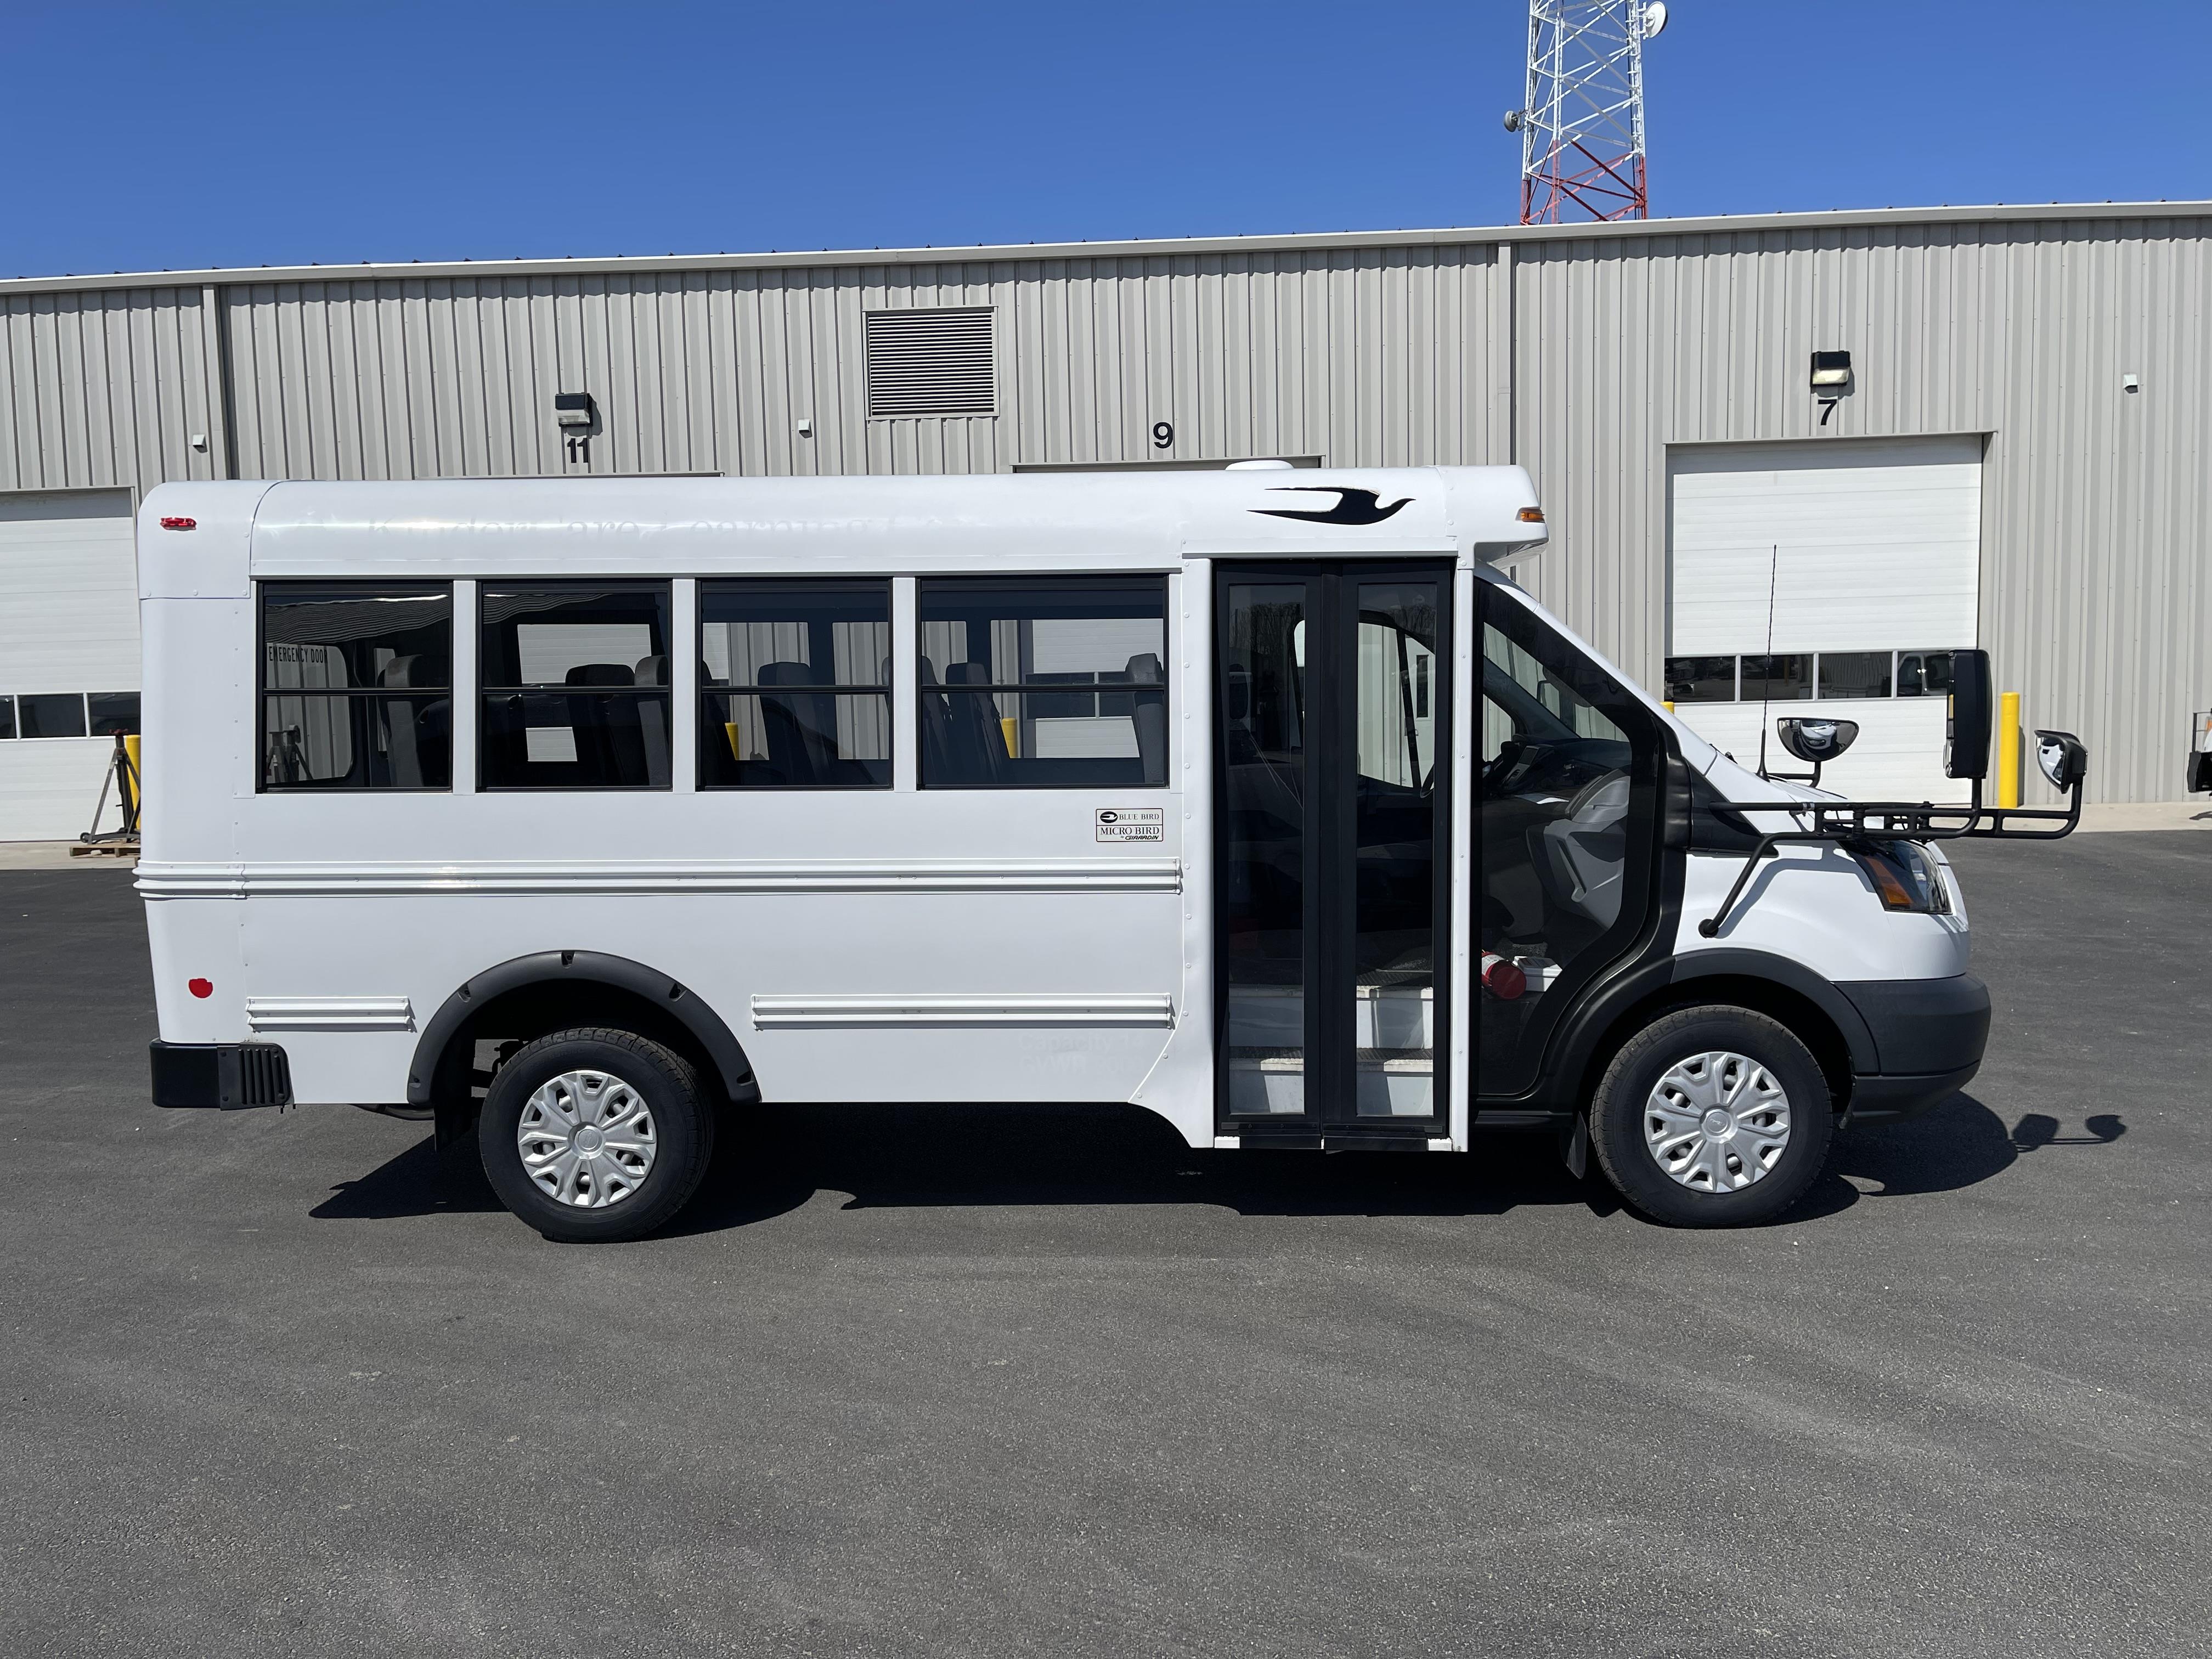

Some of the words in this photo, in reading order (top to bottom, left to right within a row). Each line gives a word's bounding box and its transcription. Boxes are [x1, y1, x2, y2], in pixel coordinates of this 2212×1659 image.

[1818, 399, 1837, 426] 7
[1153, 422, 1173, 449] 9
[567, 438, 589, 463] 11
[268, 646, 308, 662] EMERGENCY
[311, 648, 328, 663] DOOR
